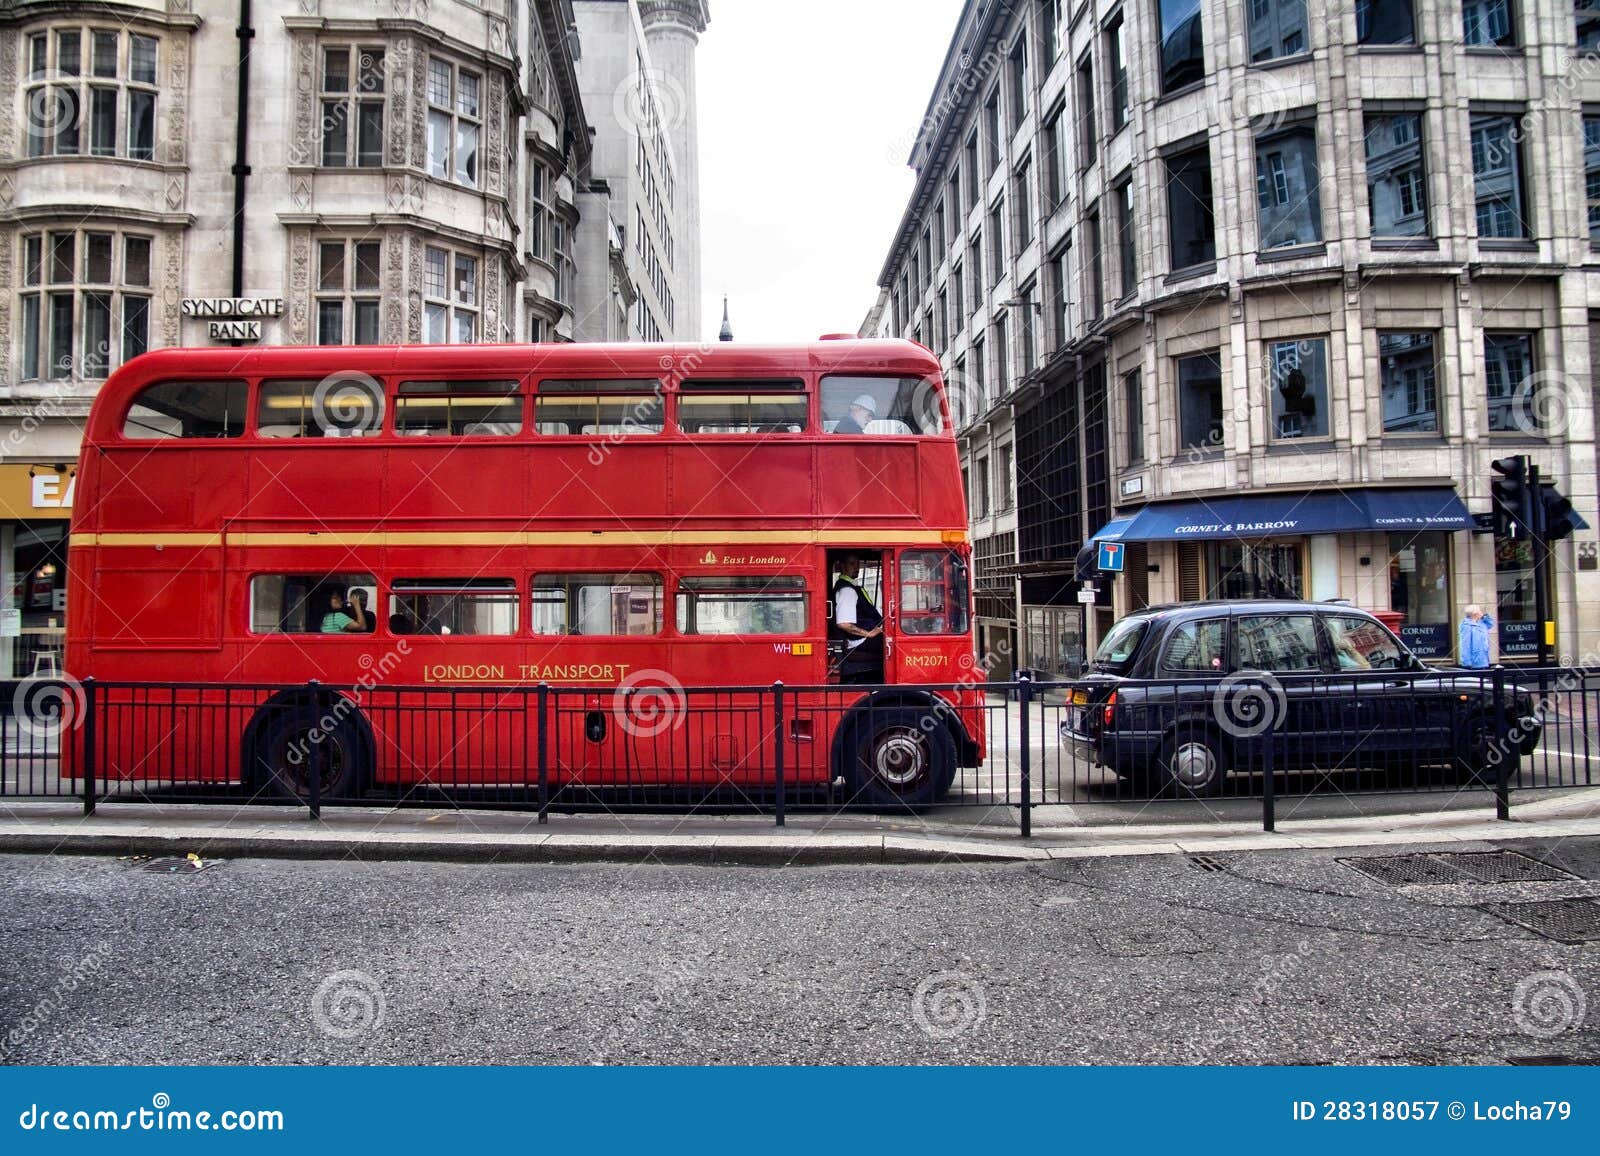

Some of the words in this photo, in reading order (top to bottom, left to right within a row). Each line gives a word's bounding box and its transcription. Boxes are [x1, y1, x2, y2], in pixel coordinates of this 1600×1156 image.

[182, 299, 283, 315] SYNDICATE
[210, 322, 258, 338] BANK
[1174, 524, 1222, 534] CORNEY
[1222, 524, 1233, 532] &
[1236, 520, 1298, 531] BARROW
[1578, 542, 1597, 558] 55
[722, 556, 745, 564] East
[749, 555, 786, 564] London
[1402, 627, 1435, 635] CORNEY
[1505, 624, 1536, 632] CORNEY
[773, 643, 791, 653] WH
[1506, 643, 1538, 651] BARROW
[905, 655, 948, 667] RM2071
[424, 664, 504, 683] LONDON
[519, 664, 630, 682] TRANSPORT
